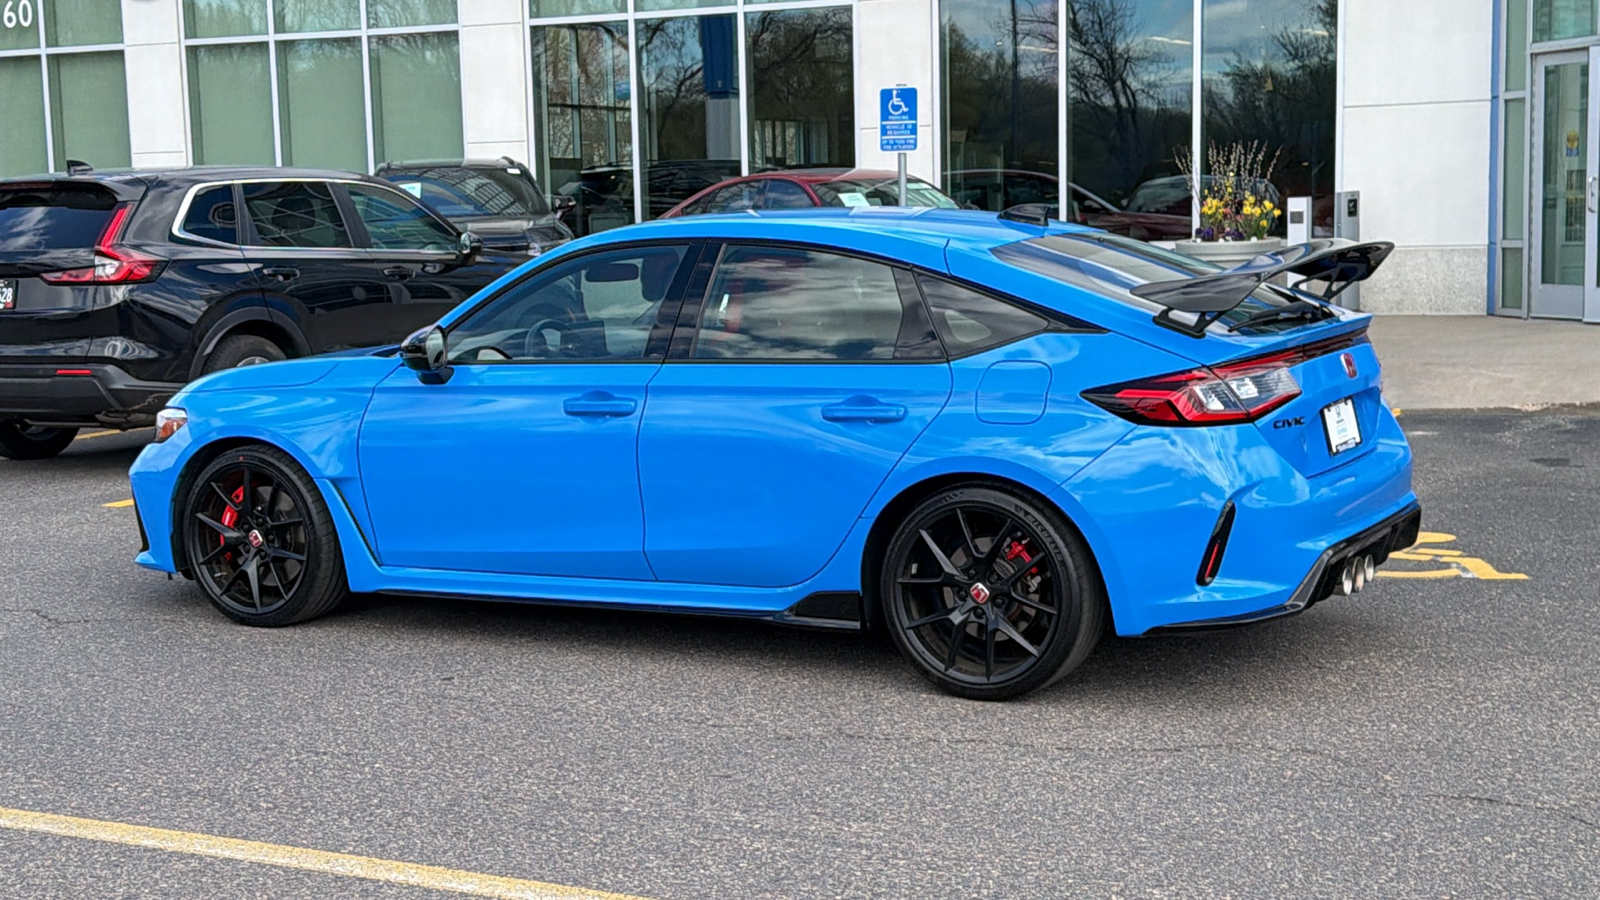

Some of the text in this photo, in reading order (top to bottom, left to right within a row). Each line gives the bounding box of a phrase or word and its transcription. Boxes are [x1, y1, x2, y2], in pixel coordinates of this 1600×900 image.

[3, 0, 33, 28] 60
[0, 287, 13, 302] 28
[1273, 415, 1305, 429] CIVIC
